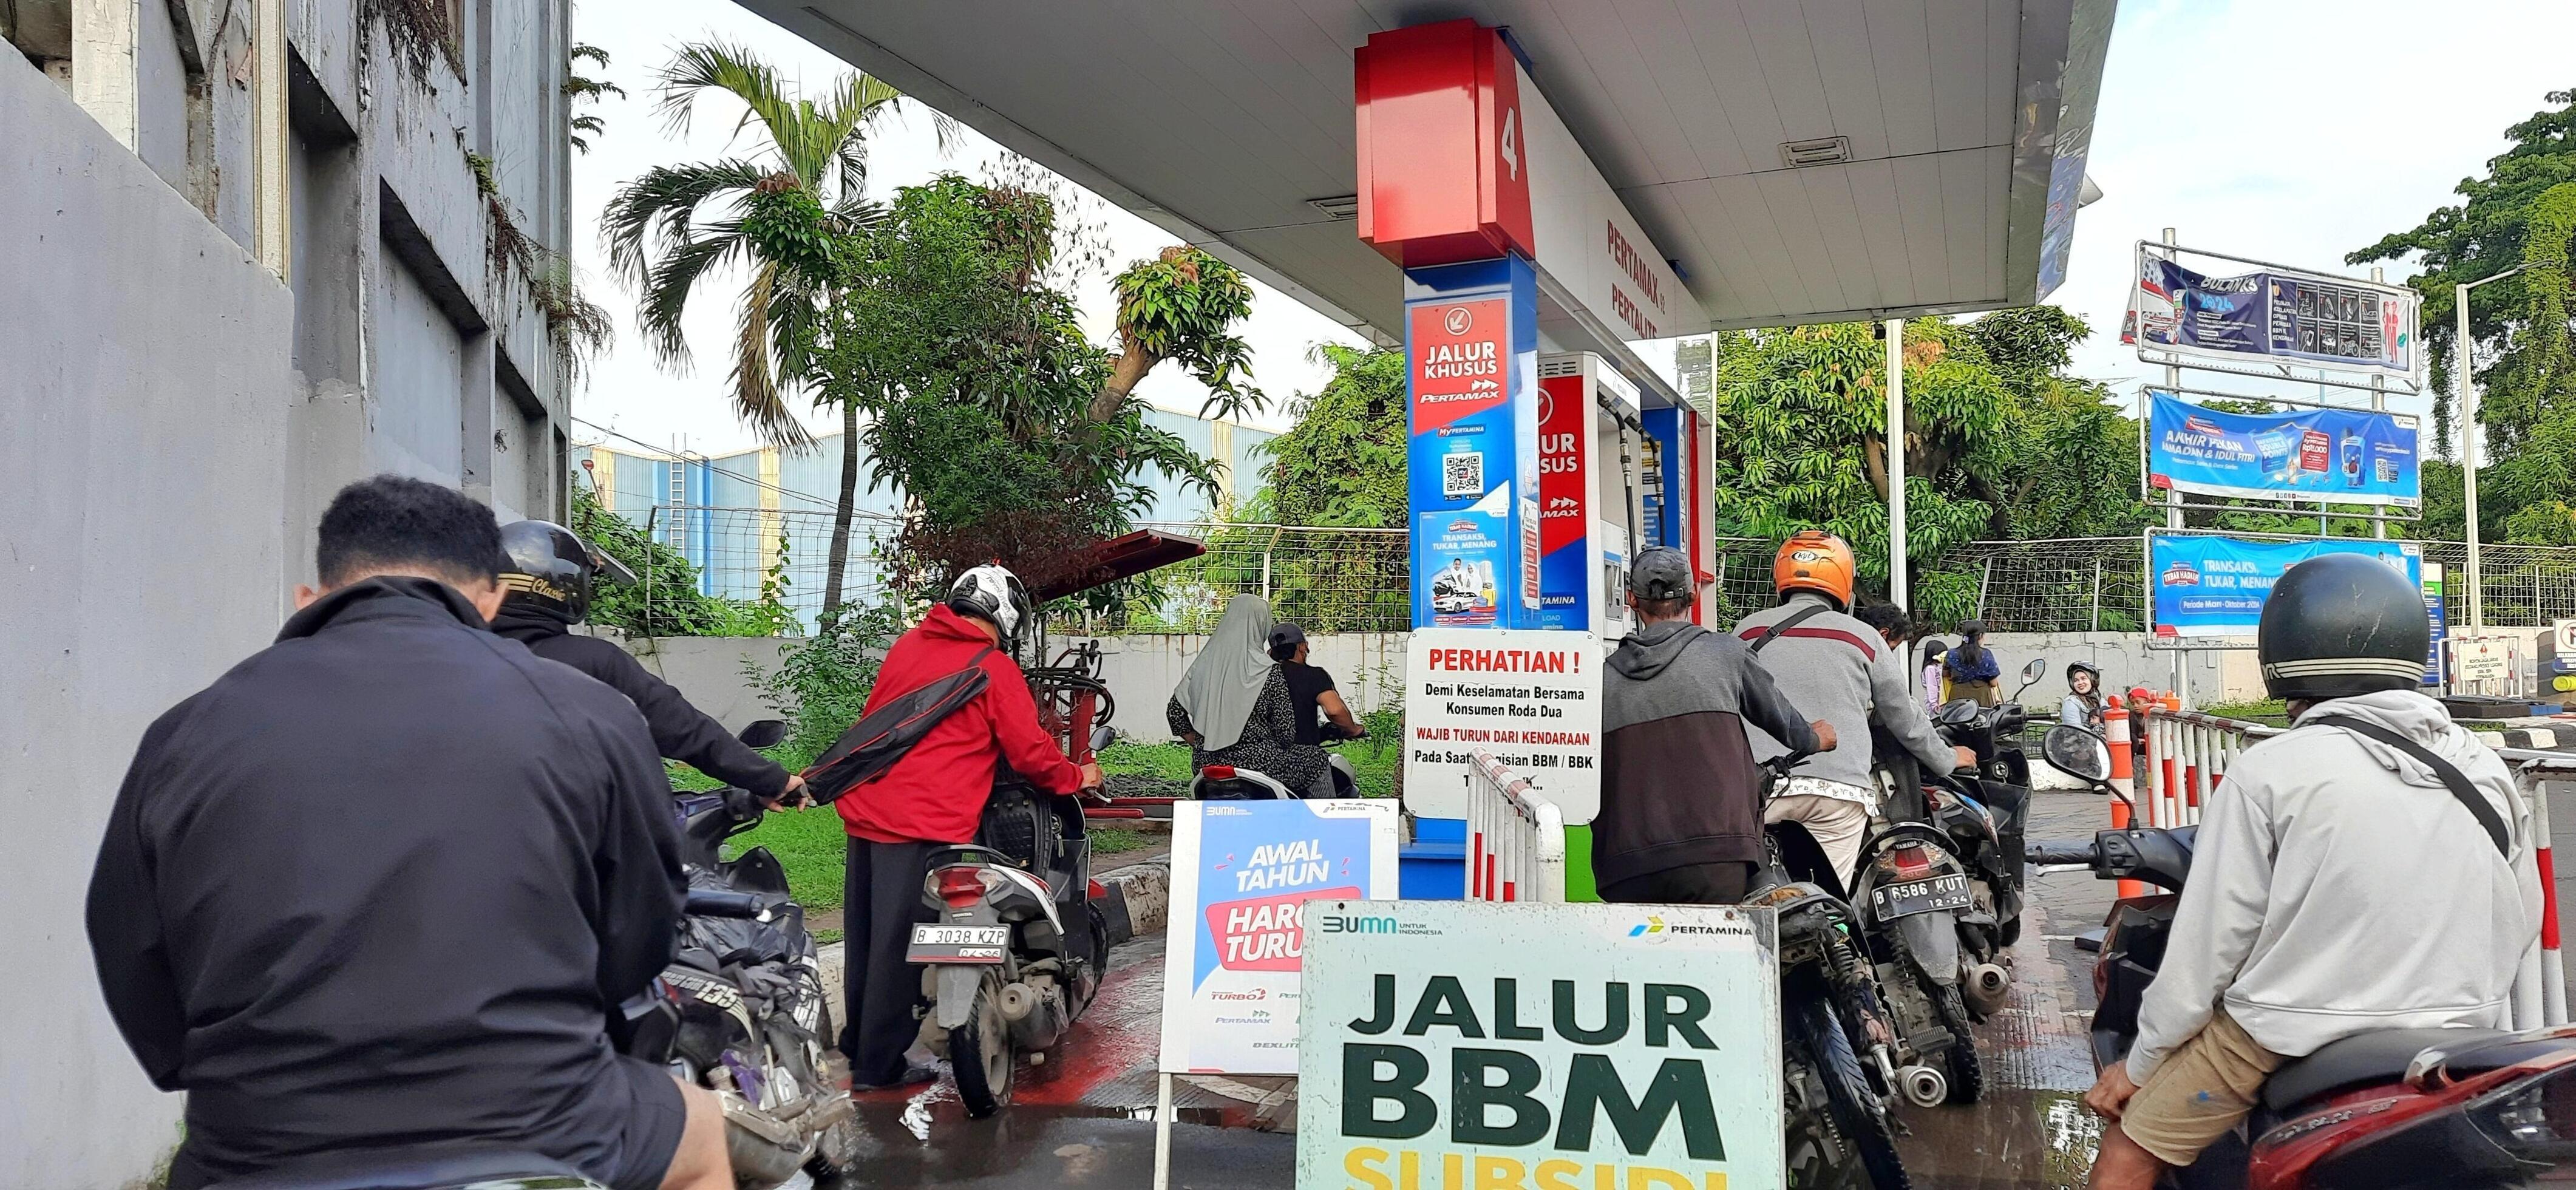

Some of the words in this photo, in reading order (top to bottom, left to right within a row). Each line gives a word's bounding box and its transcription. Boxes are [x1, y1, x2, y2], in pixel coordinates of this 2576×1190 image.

[1501, 106, 1517, 182] 4
[1607, 219, 1659, 308] PERTAMAX
[1612, 282, 1657, 340] PERTALITE
[2199, 293, 2235, 311] 2024
[1425, 341, 1496, 364] JALUR
[1425, 360, 1497, 379] KHUSUS
[1420, 391, 1500, 404] PERTAMAX
[1541, 433, 1575, 454] UR
[2166, 430, 2207, 447] AKHIR
[1540, 456, 1577, 474] SUS
[2205, 450, 2213, 459] &
[2215, 451, 2235, 461] IDUL
[2236, 453, 2255, 463] FITRI
[1540, 509, 1579, 518] MAX
[1433, 542, 1460, 550] TUKAR,
[1442, 533, 1486, 542] TRANSAKSI,
[2204, 560, 2259, 575] TRANSAKSI,
[2163, 573, 2180, 582] TEBAR
[2205, 576, 2238, 589] TUKAR,
[2240, 578, 2277, 589] MENAN
[532, 579, 566, 602] Classic
[1542, 596, 1575, 605] TAMINA
[1430, 649, 1565, 673] PERHATIAN
[1574, 652, 1579, 673] !
[1426, 684, 1453, 696] Demi
[1457, 684, 1530, 698] Keselamatan
[1534, 687, 1585, 700] Bersama
[1446, 702, 1504, 716] Konsumen
[1509, 704, 1536, 717] Roda
[1541, 706, 1562, 718] Dua
[1416, 727, 1450, 740] WAJIB
[1453, 729, 1490, 742] TURUN
[1494, 730, 1518, 743] DARI
[1522, 731, 1589, 746] KENDARAAN
[1415, 750, 1441, 763] Pada
[1446, 751, 1471, 764] Saat
[1495, 753, 1528, 766] isian
[1532, 755, 1558, 767] BBM
[1562, 755, 1565, 768] /
[1569, 756, 1593, 769] BBK
[1248, 839, 1322, 869] AWAL
[1895, 841, 1917, 849] YAMAHA
[1236, 860, 1330, 892] TAHUN
[1875, 891, 1884, 904] B
[1892, 883, 1928, 899] 6586
[1935, 876, 1965, 894] KUT
[1323, 916, 1396, 934] BUMN
[1671, 926, 1752, 936] PERTAMINA
[917, 930, 926, 942] B
[936, 930, 971, 943] 3038
[978, 930, 1005, 943] KZP
[1226, 931, 1303, 962] TURU
[693, 981, 740, 1008] 135
[1347, 973, 1720, 1051] JALUR
[1341, 1042, 1727, 1162] BBM
[1343, 1146, 1729, 1190] SUBSIDI
